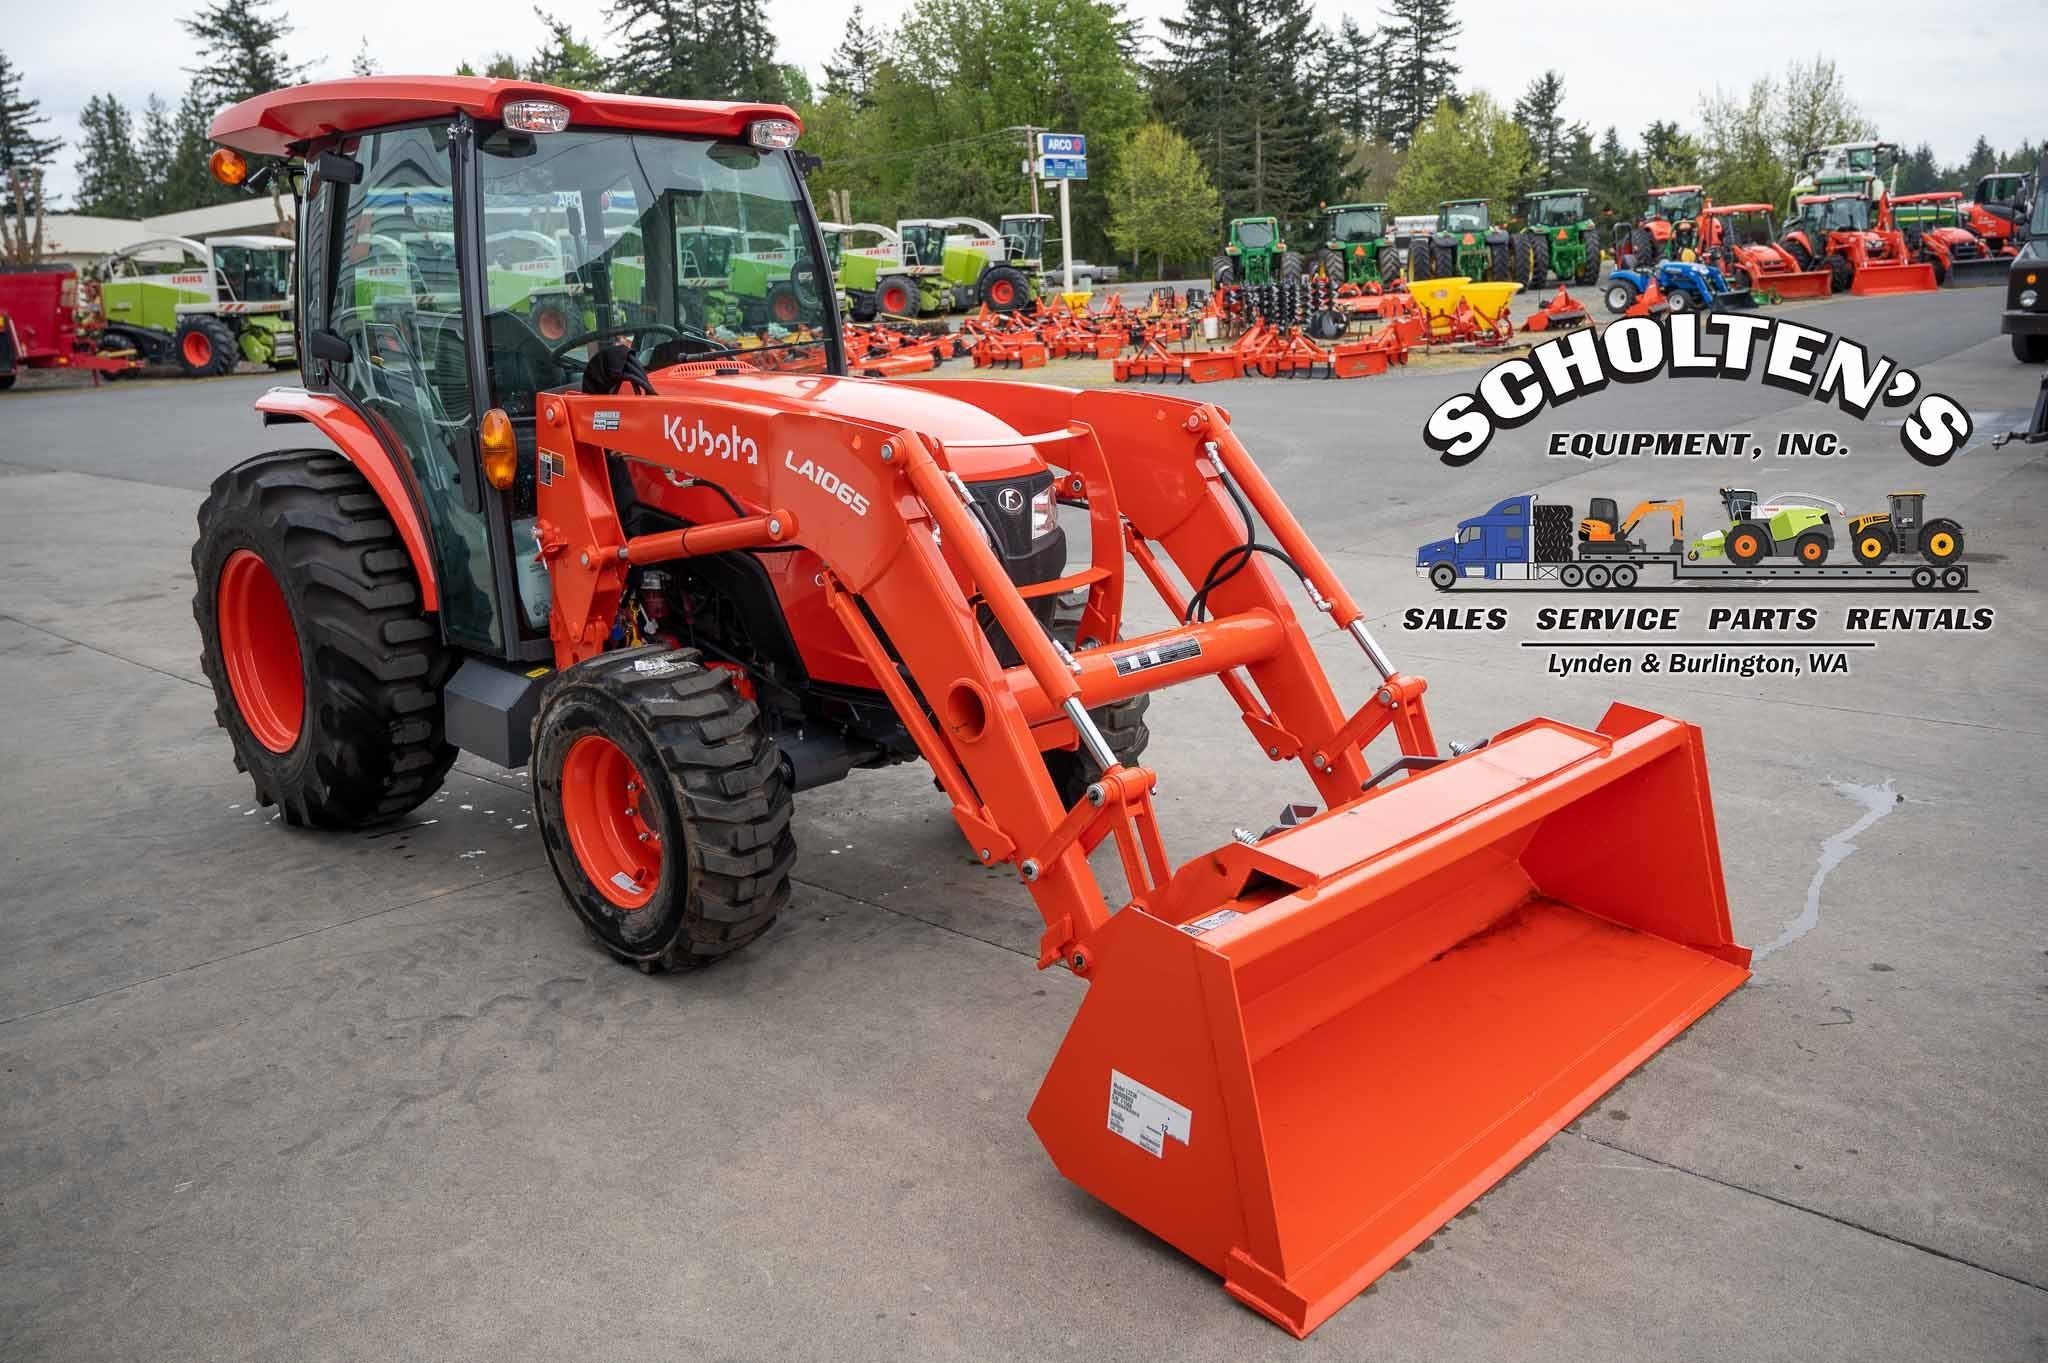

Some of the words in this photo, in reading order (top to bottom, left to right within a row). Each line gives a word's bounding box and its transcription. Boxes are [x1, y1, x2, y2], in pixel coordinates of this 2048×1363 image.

[1047, 138, 1073, 151] ARCO
[663, 414, 758, 465] Kubota
[785, 449, 871, 517] LA1065
